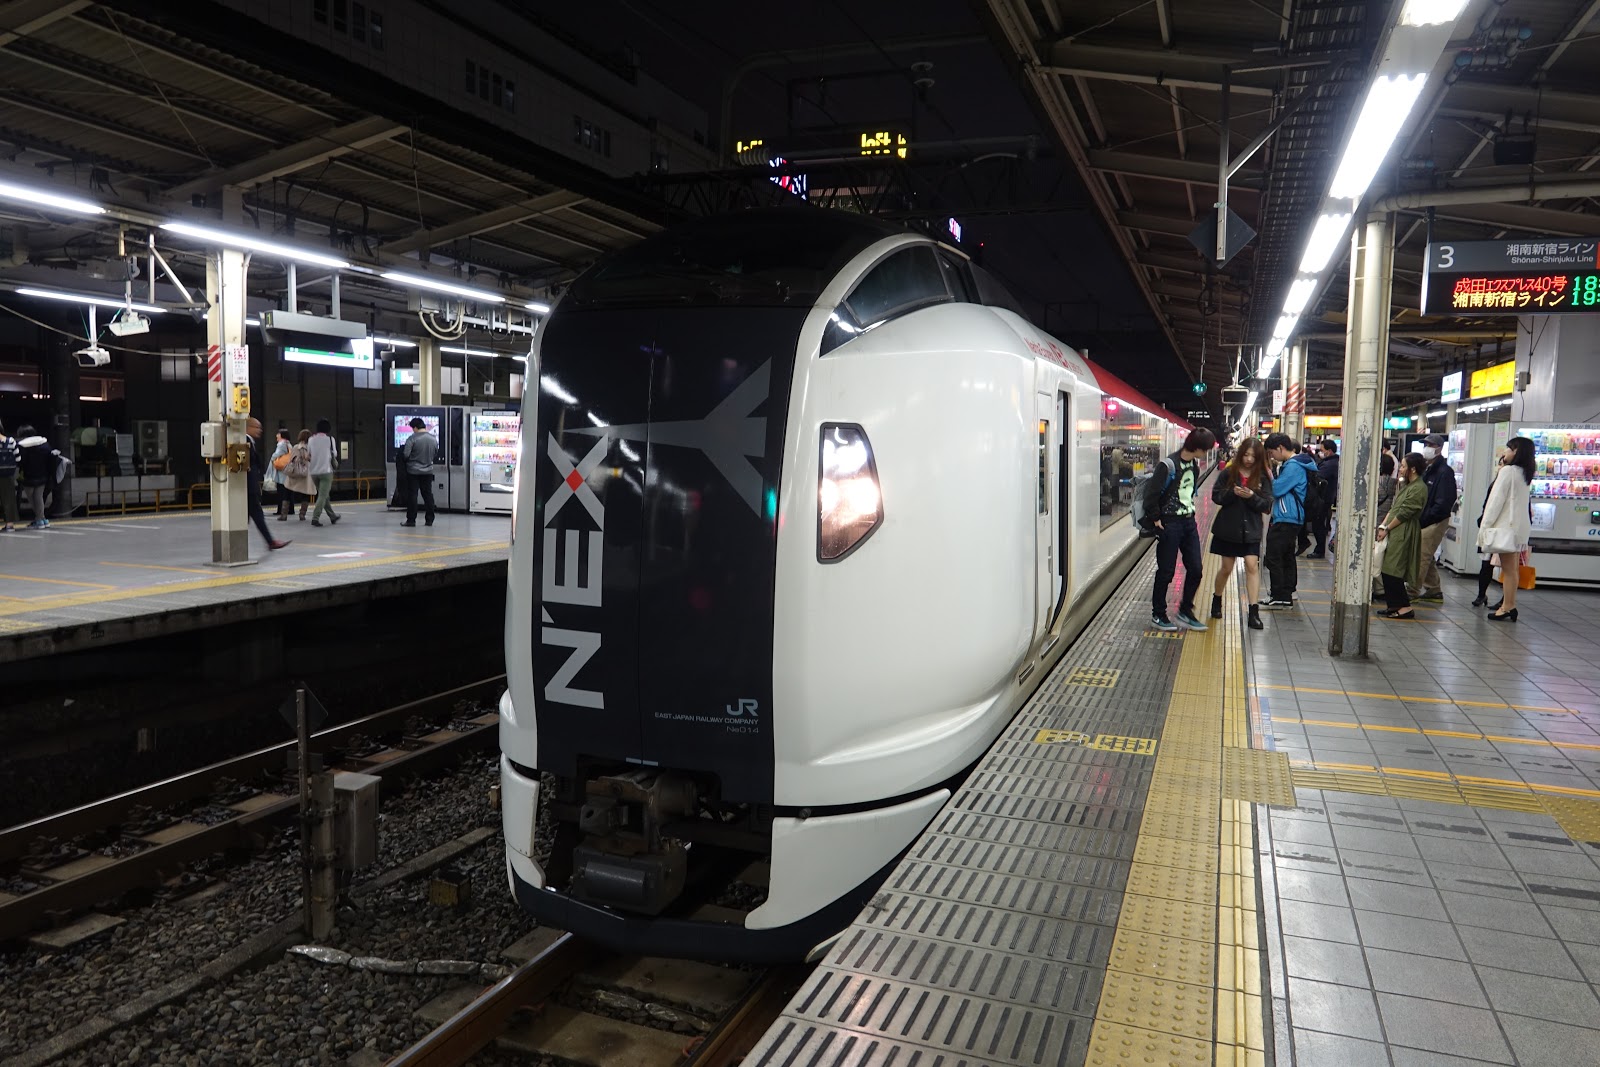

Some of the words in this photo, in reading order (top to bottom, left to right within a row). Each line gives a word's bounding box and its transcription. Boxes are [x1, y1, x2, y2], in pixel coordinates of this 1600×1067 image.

[1438, 245, 1454, 268] 3
[1506, 243, 1594, 256] 湘南新宿ライン
[1452, 290, 1566, 308] 湘南新宿ライン
[726, 698, 759, 717] JR
[654, 711, 672, 719] EAST
[672, 714, 695, 722] JAPAN
[695, 716, 724, 724] RAILWAY
[724, 717, 759, 726] COMPANY
